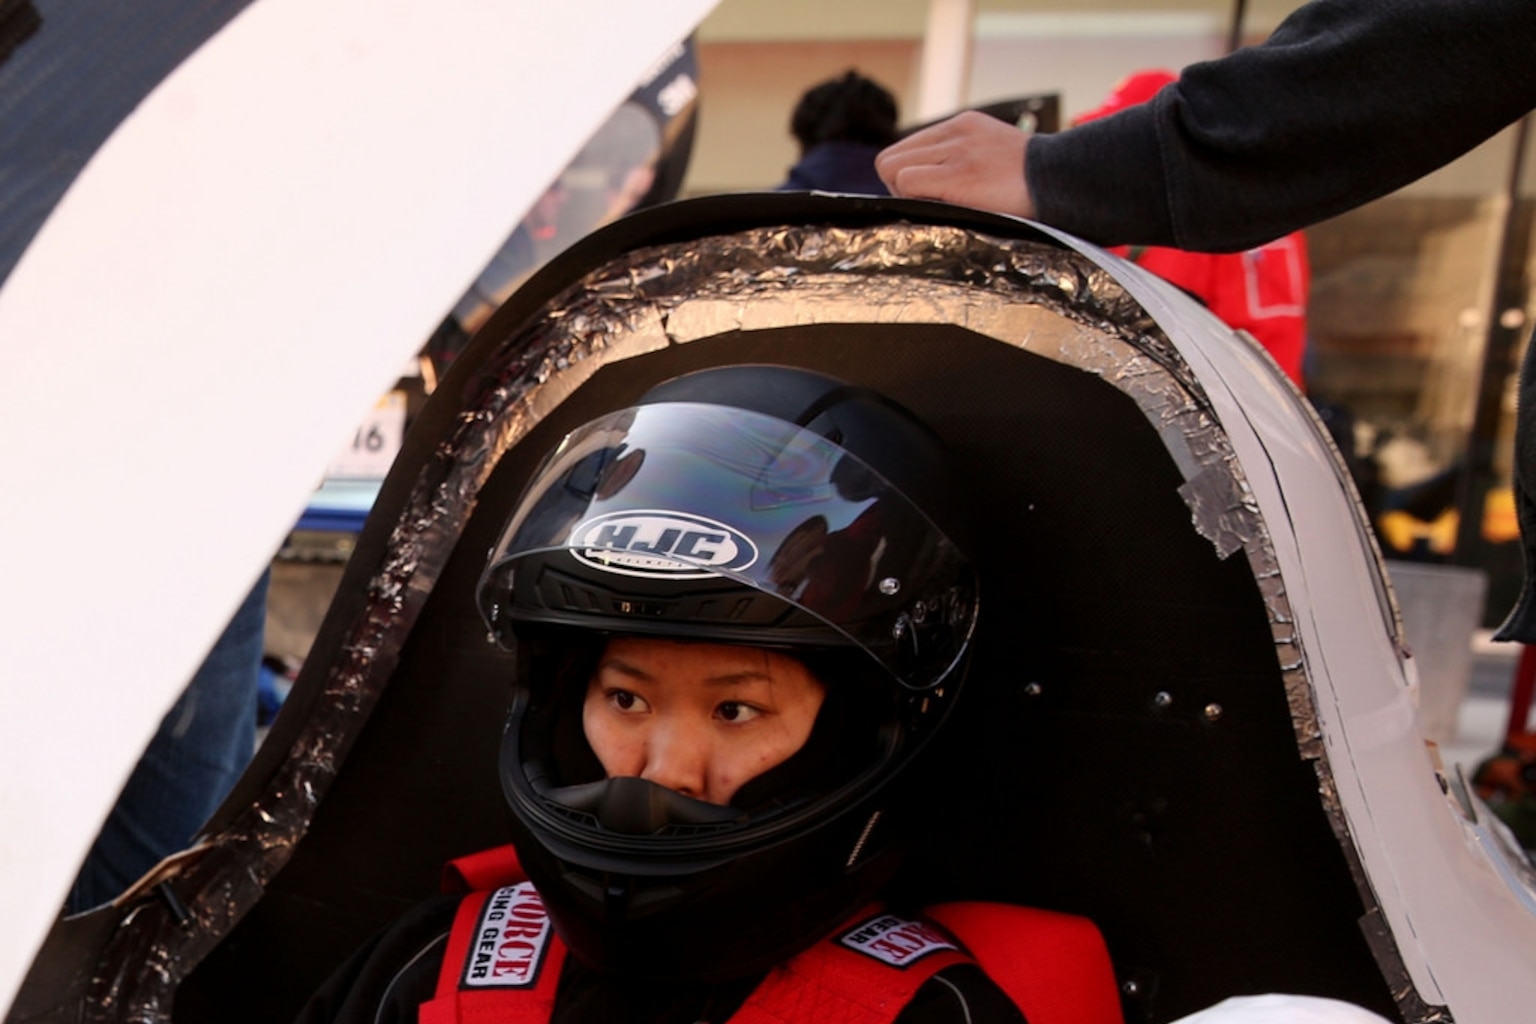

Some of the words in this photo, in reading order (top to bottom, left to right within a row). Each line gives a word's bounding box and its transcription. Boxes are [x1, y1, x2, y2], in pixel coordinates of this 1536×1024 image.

[593, 524, 726, 560] HJC
[848, 918, 900, 945] GEAR
[471, 927, 500, 979] GEAR
